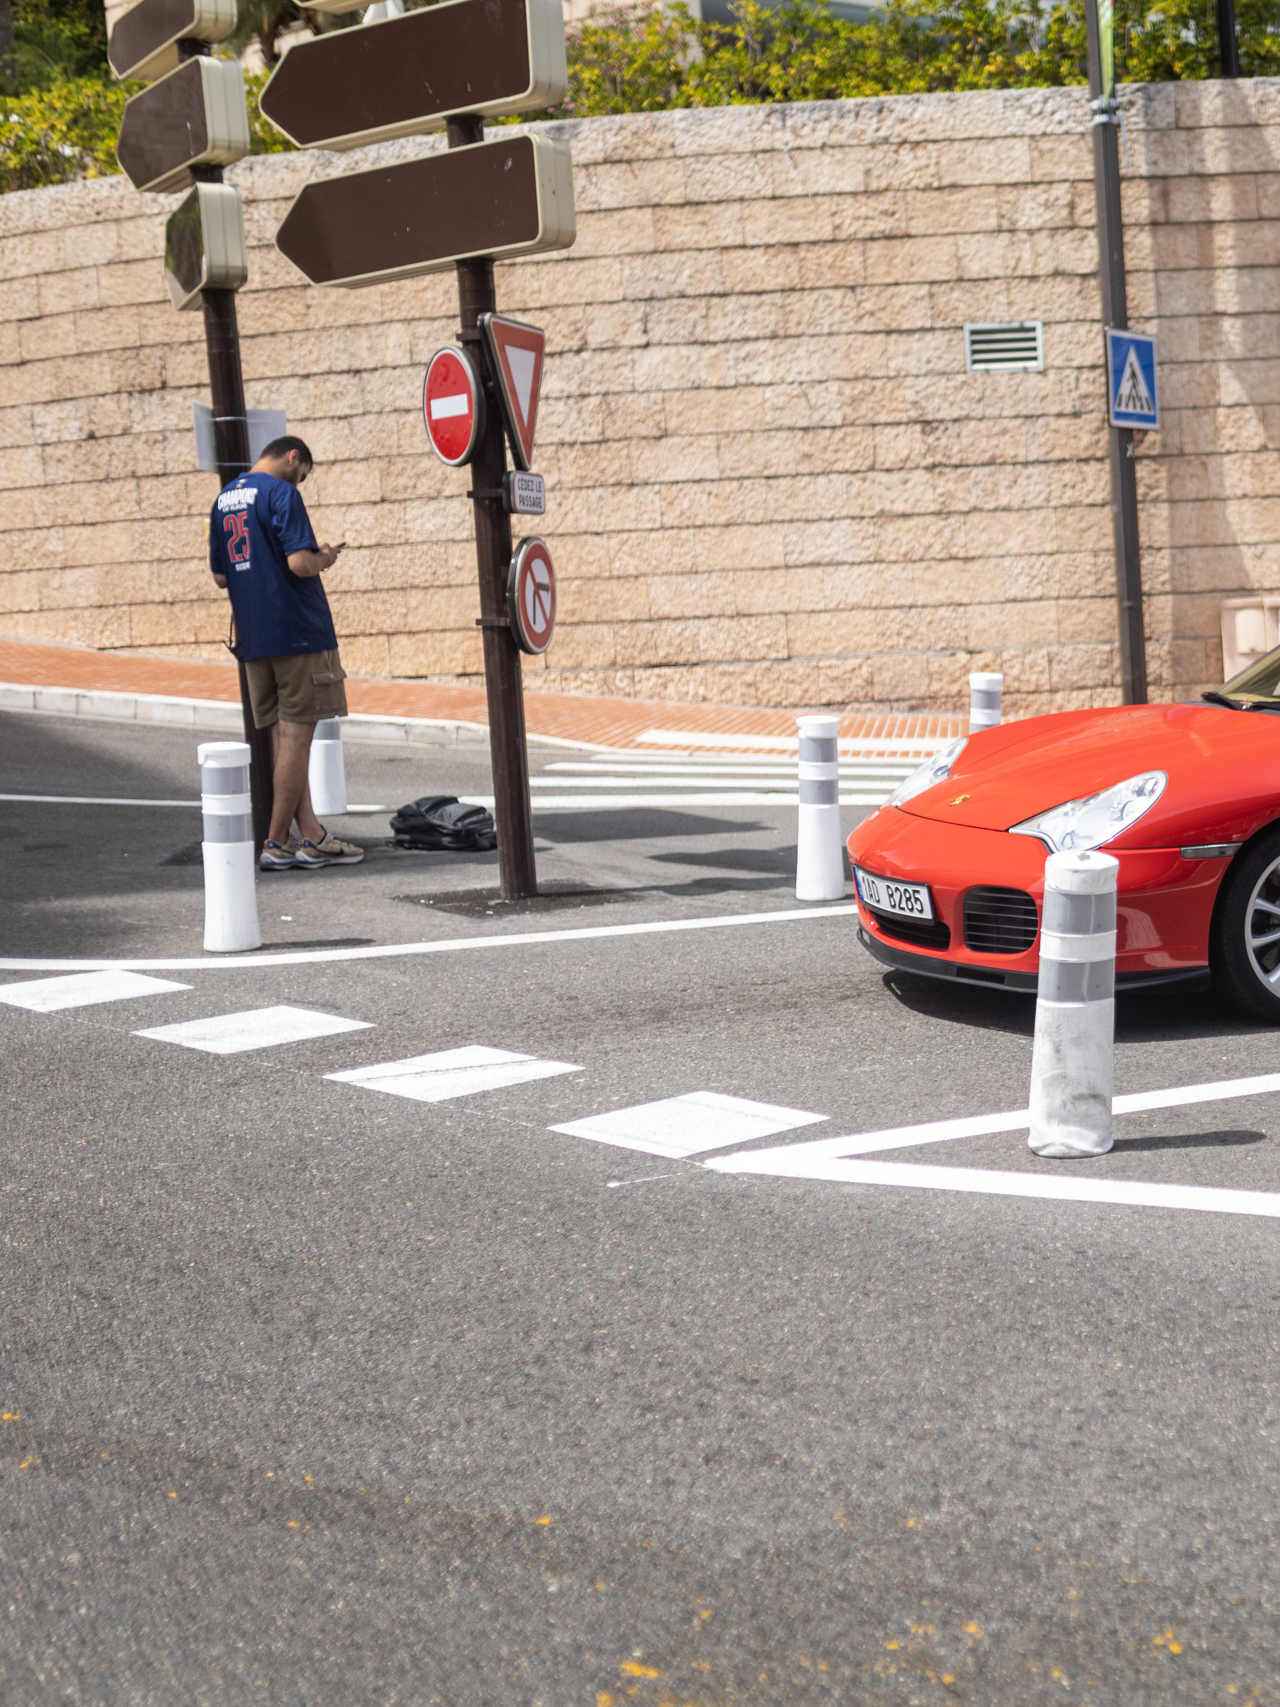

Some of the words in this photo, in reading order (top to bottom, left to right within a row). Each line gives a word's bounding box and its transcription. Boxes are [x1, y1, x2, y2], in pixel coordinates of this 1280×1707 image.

[517, 475, 534, 492] CÉDEZ
[536, 480, 543, 493] LE
[518, 494, 543, 509] PASSAGE
[223, 511, 251, 563] 25
[861, 875, 880, 903] 1AD
